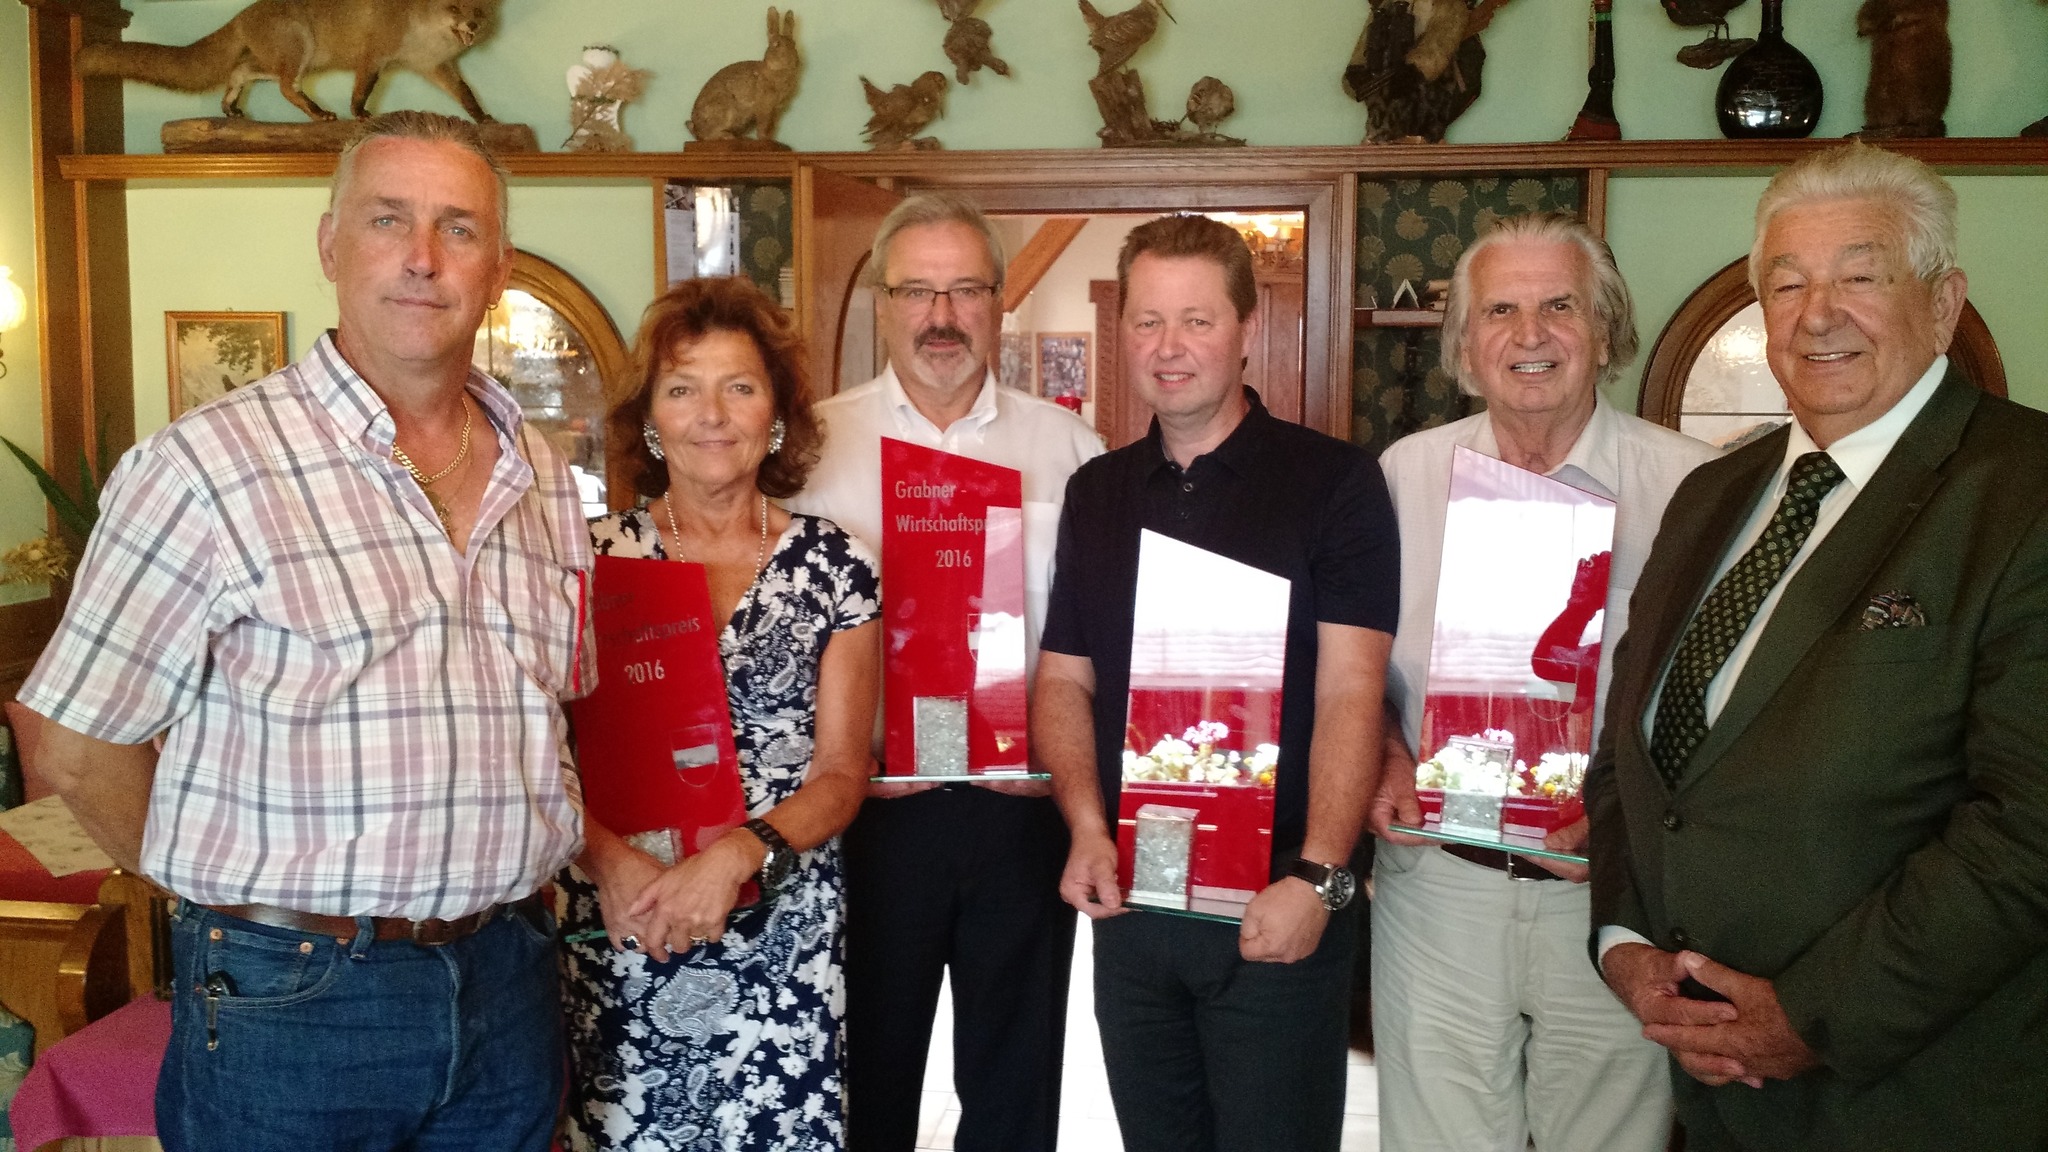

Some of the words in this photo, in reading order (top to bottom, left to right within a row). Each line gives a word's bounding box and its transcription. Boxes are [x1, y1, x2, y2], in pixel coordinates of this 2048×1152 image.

[895, 480, 957, 498] Grabner
[935, 549, 972, 568] 2016
[624, 659, 665, 684] 2016
